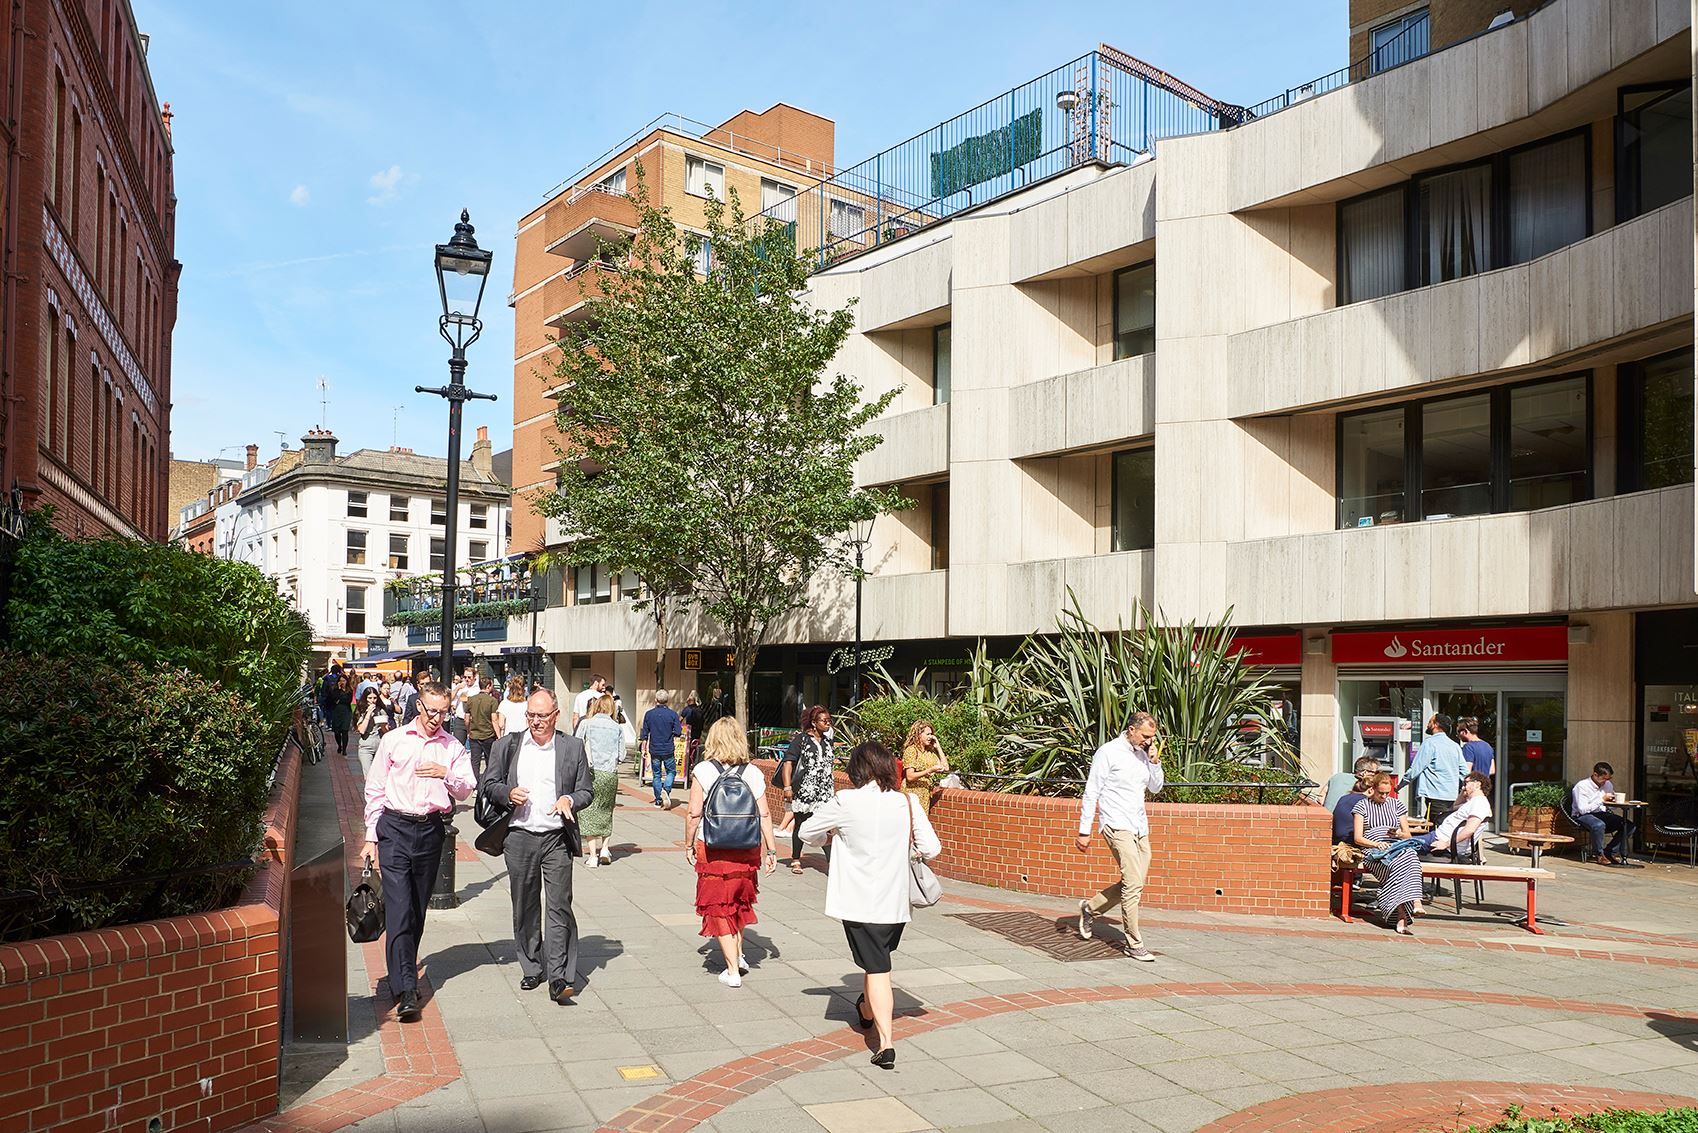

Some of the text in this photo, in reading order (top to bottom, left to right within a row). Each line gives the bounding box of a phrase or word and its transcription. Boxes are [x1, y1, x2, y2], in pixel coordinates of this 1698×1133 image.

[424, 625, 440, 642] THE
[1411, 636, 1506, 657] Santander
[826, 645, 895, 675] Chiango
[928, 658, 956, 666] STAMPEDE
[956, 658, 964, 666] OF
[1647, 745, 1677, 753] BREAKFAST
